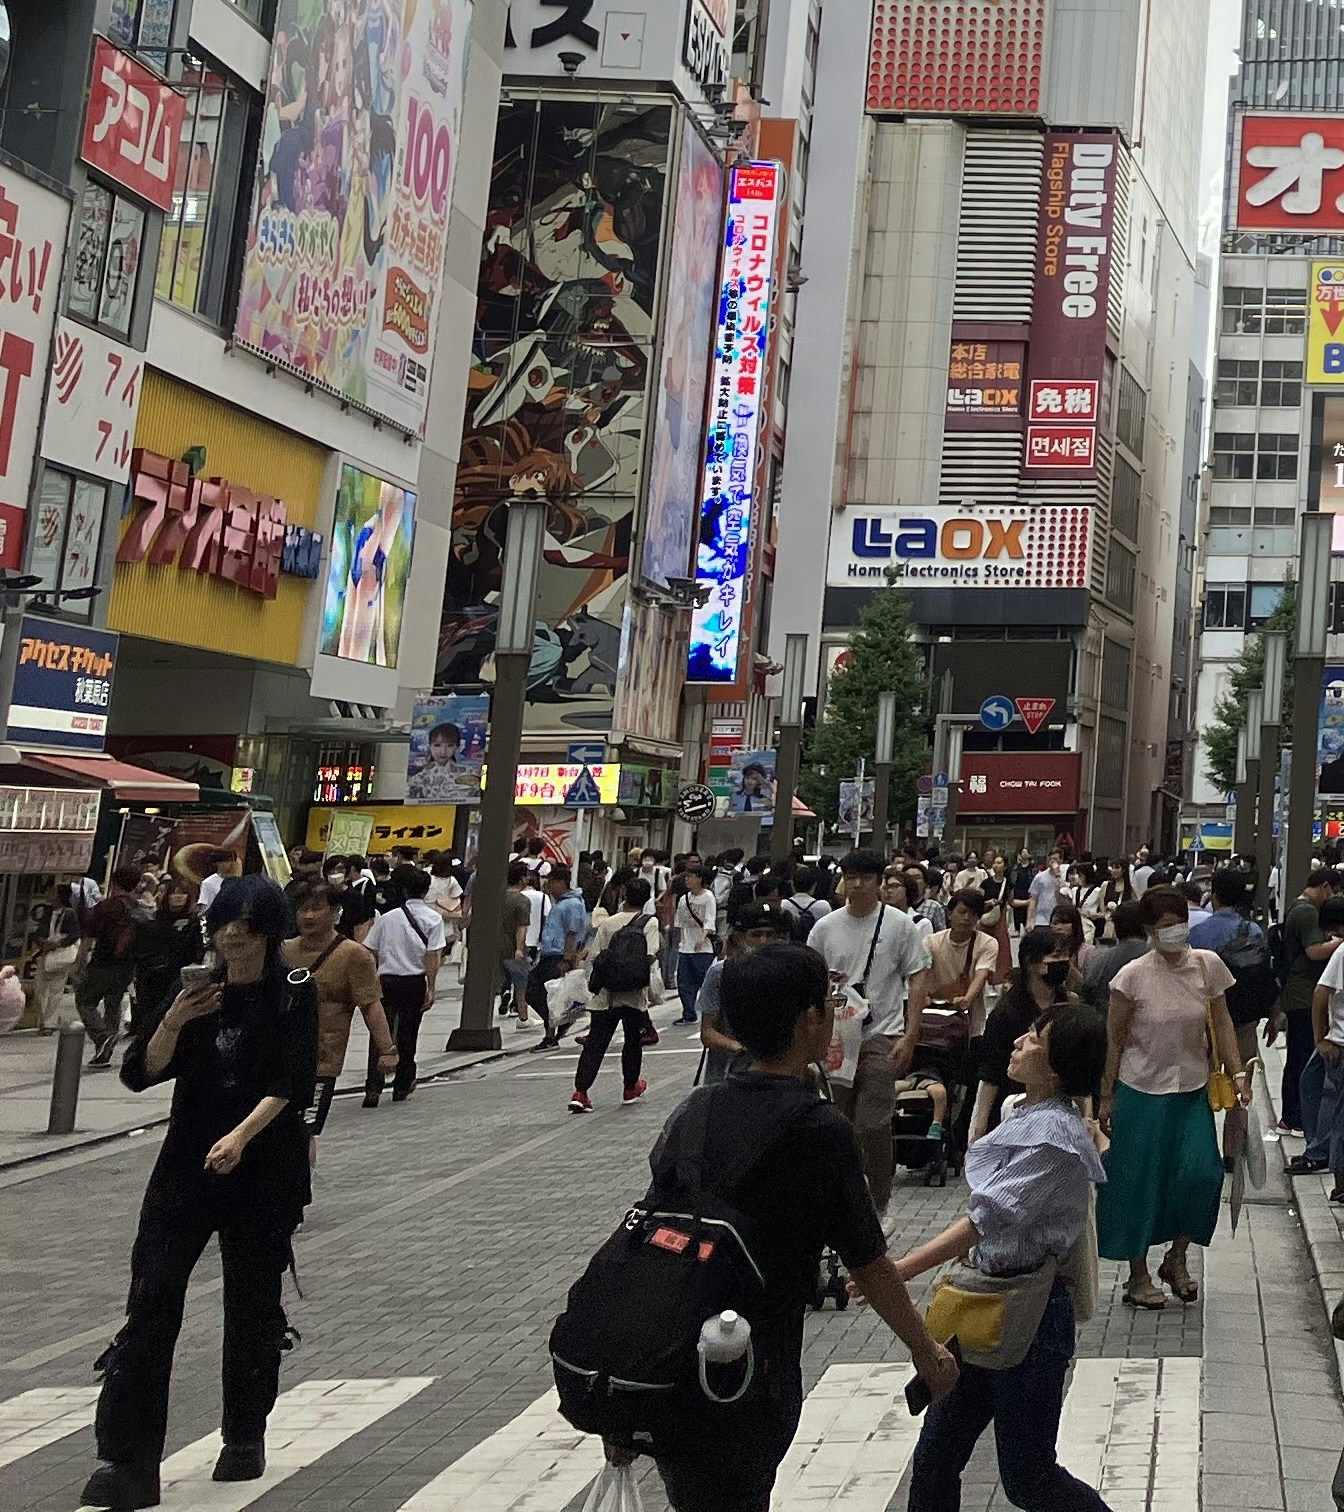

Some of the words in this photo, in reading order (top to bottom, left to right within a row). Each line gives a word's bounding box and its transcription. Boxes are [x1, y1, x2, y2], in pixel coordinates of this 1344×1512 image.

[1047, 141, 1070, 220] Flagship
[1064, 141, 1114, 230] Duty
[1043, 223, 1064, 278] Store
[1061, 235, 1108, 320] Free
[735, 214, 770, 396] コロナウィルス対策
[951, 343, 989, 361] 本店
[1035, 387, 1093, 415] 免税
[1031, 436, 1091, 458] 면세점
[985, 563, 1025, 578] Store
[20, 638, 113, 677] アクセスチケット
[1022, 702, 1047, 711] 止まれ
[1026, 711, 1044, 719] STOP
[375, 825, 443, 839] ライオン
